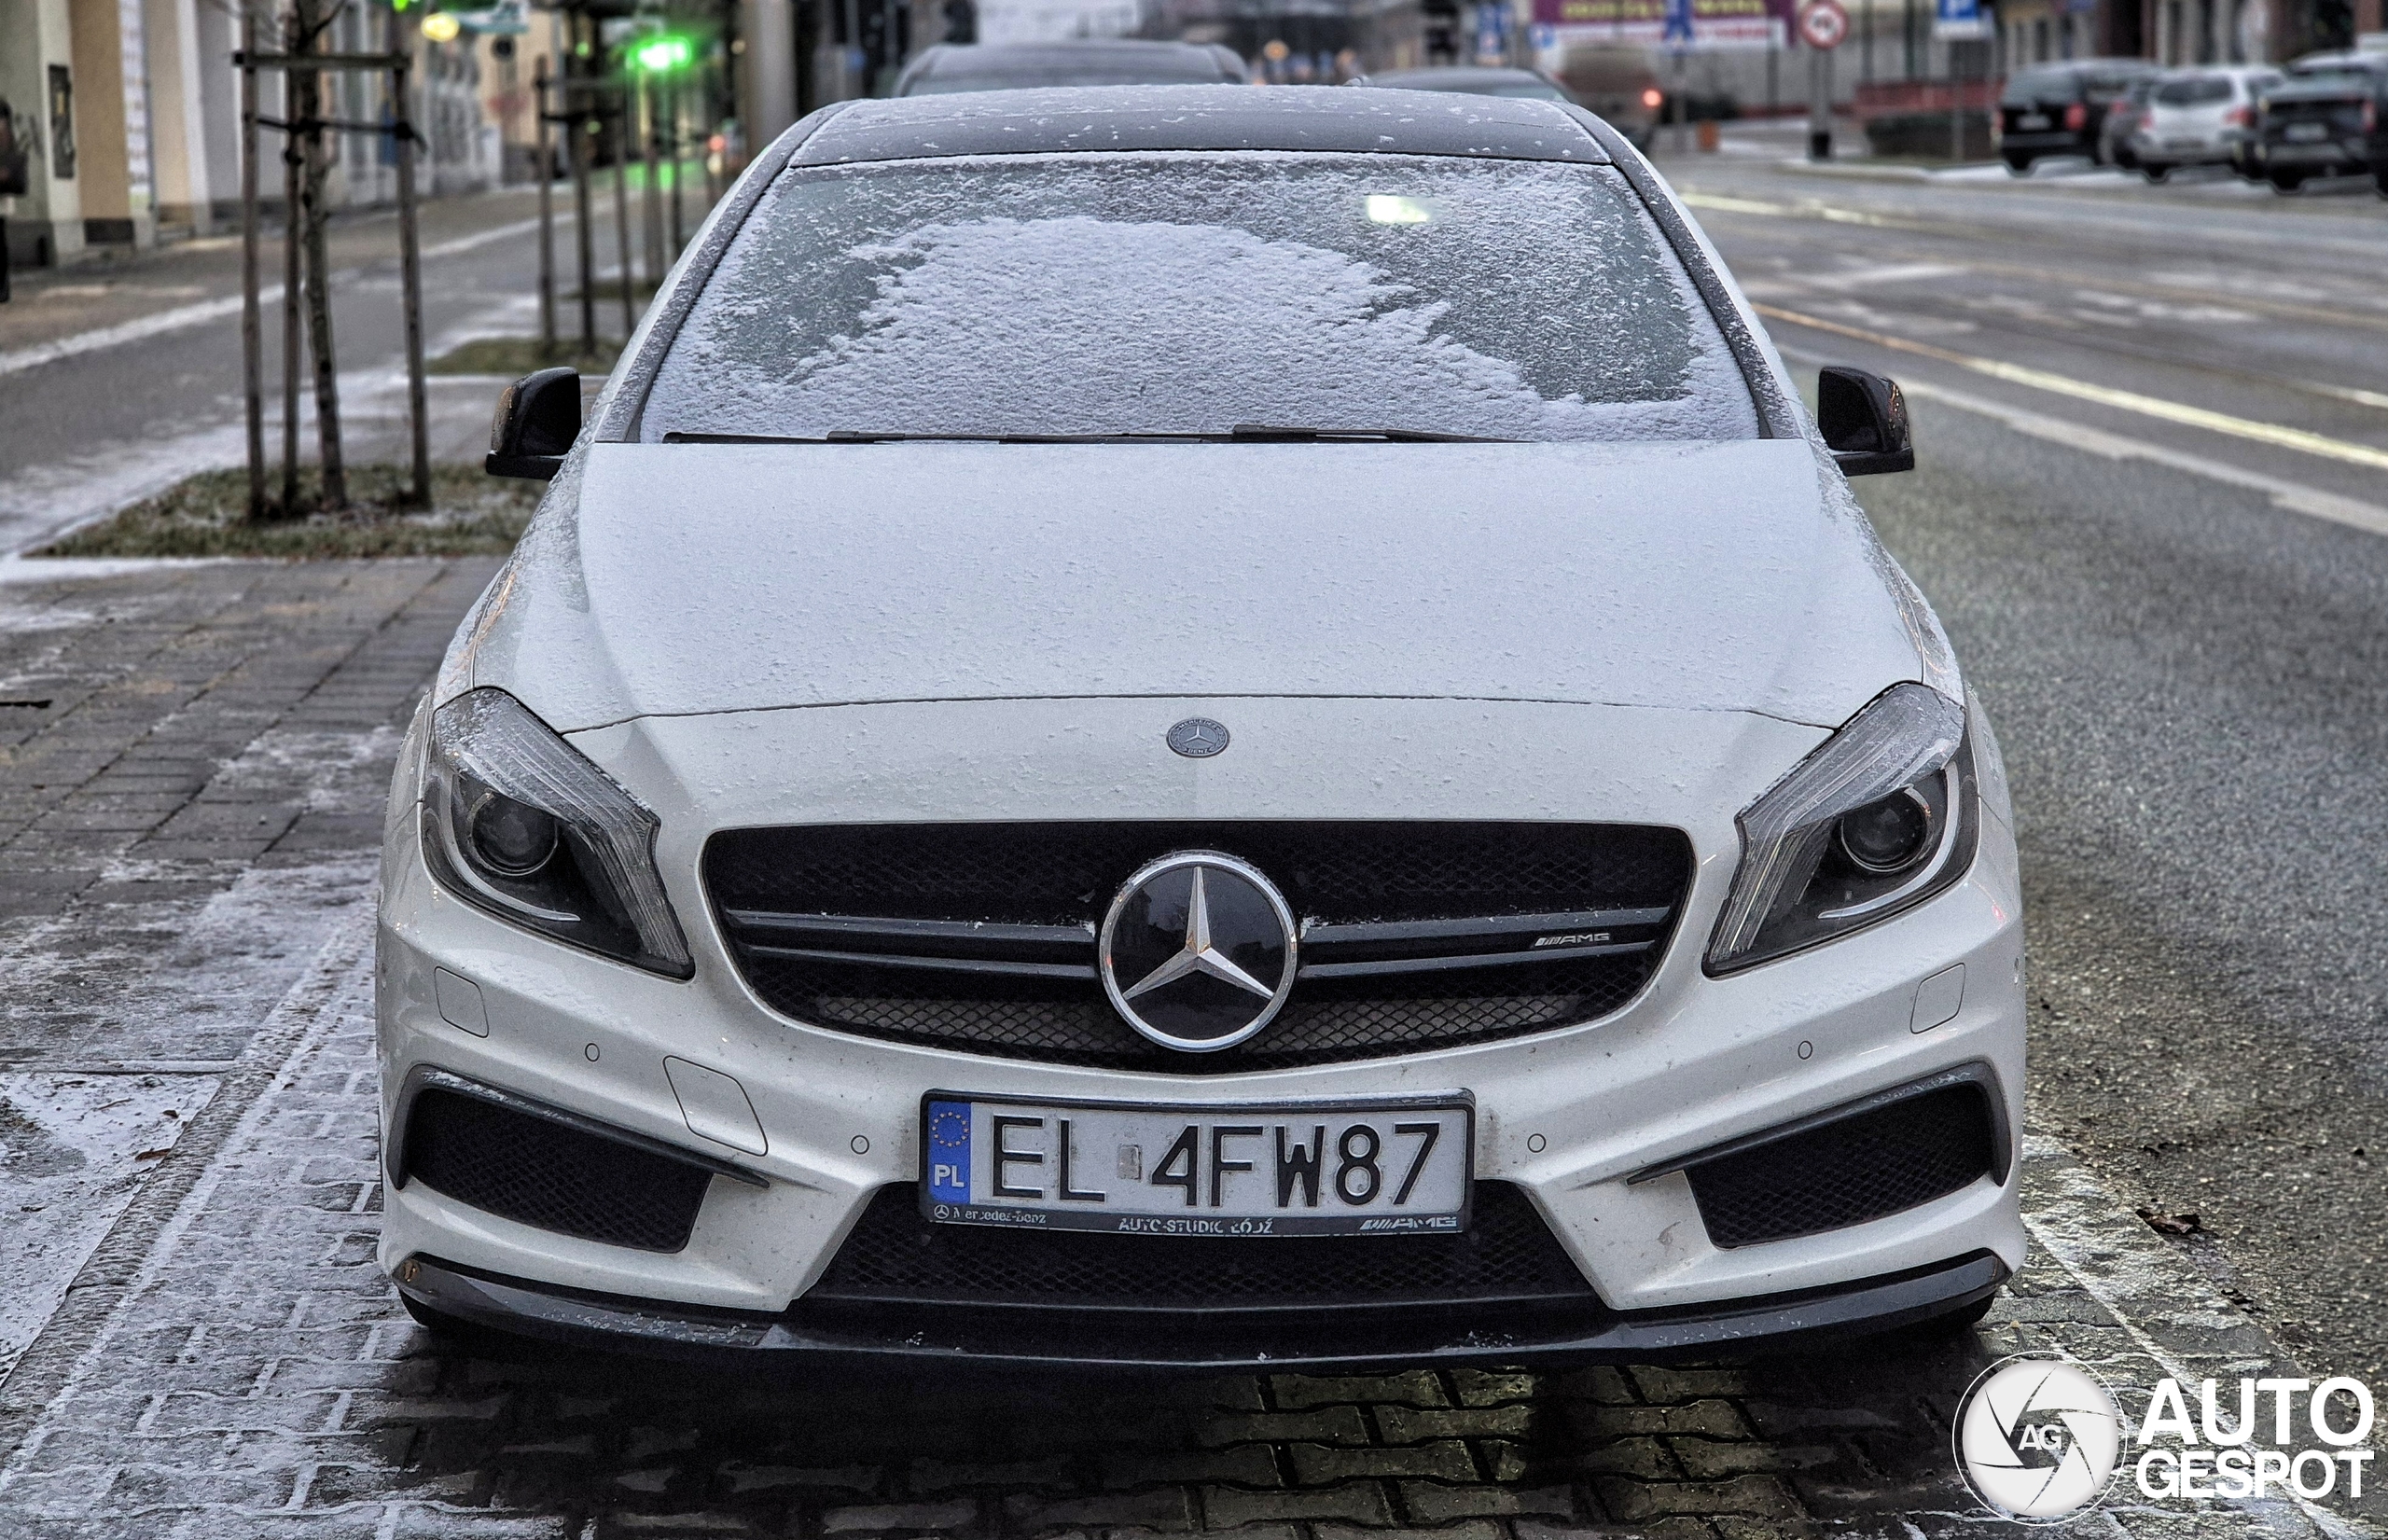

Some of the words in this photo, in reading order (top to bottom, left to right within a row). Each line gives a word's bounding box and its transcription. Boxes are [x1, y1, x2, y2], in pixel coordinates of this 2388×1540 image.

[1559, 933, 1610, 945] AMG
[993, 1115, 1106, 1201] EL
[1151, 1122, 1440, 1207] 4FW87
[935, 1165, 965, 1187] PL
